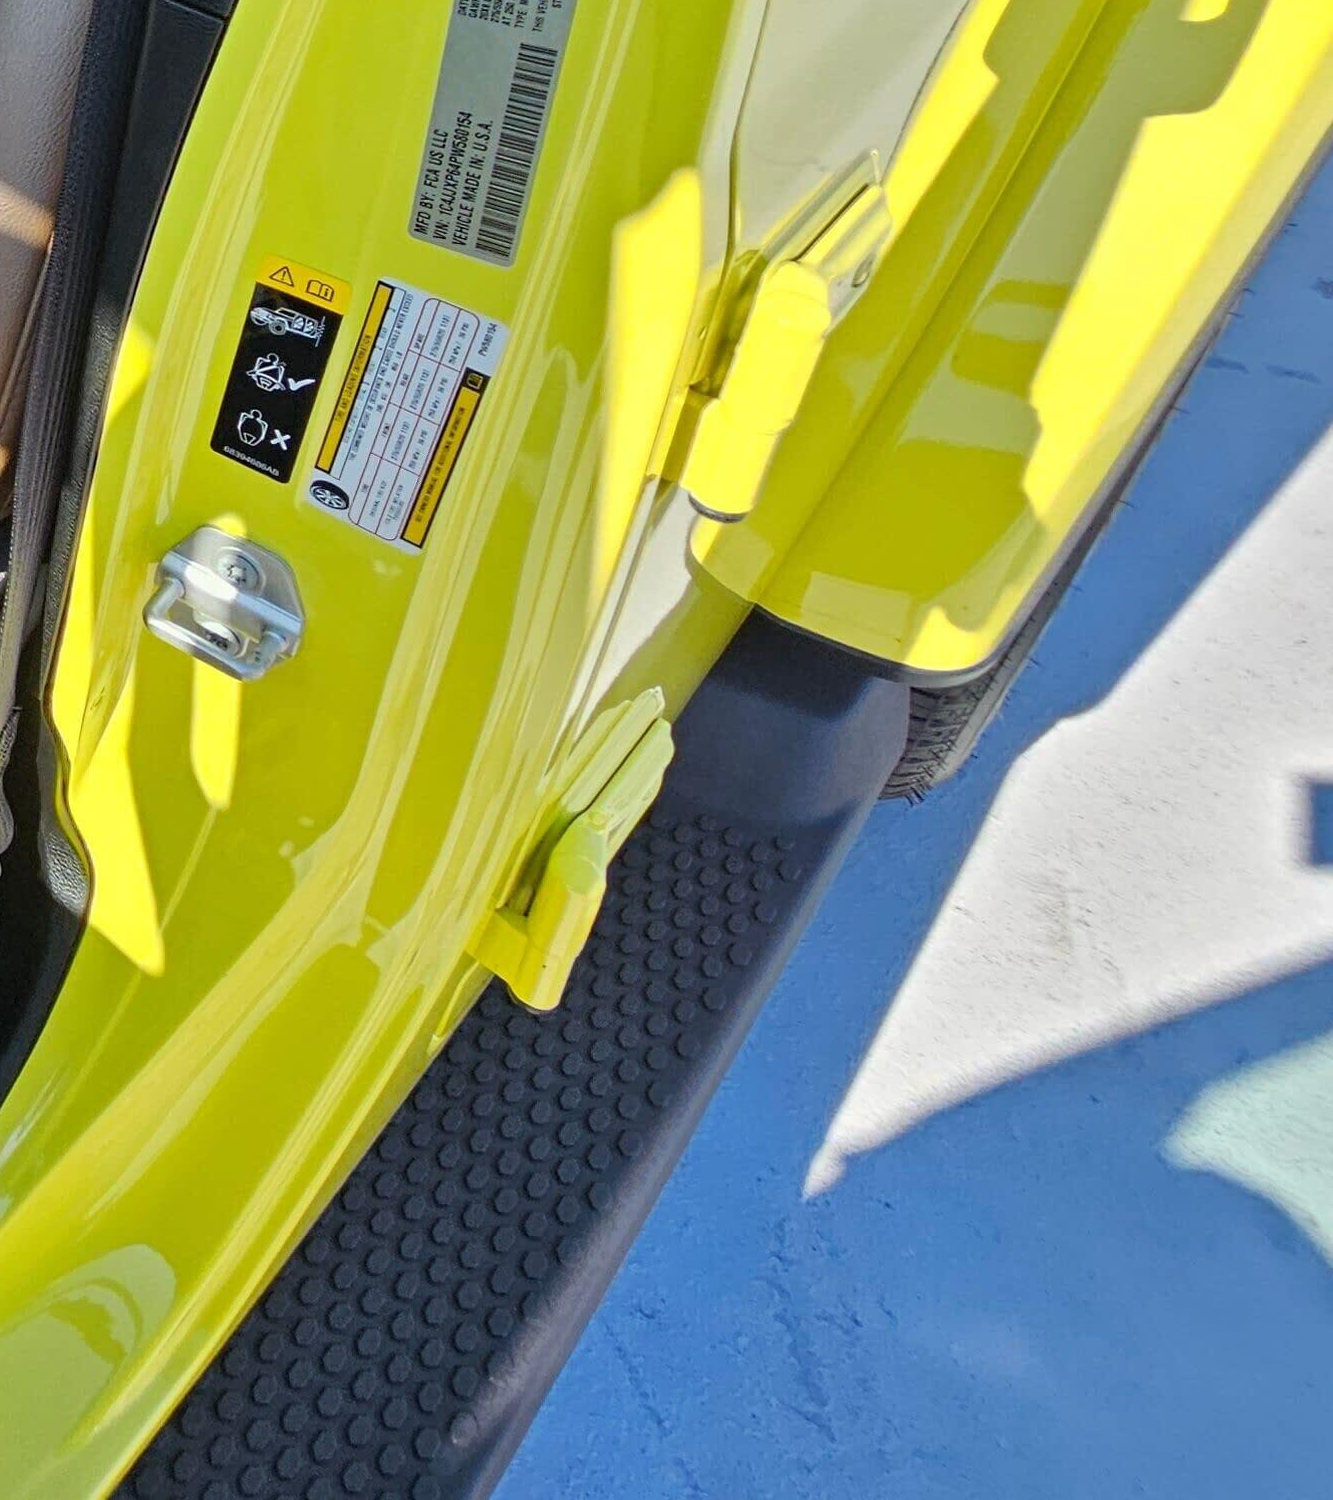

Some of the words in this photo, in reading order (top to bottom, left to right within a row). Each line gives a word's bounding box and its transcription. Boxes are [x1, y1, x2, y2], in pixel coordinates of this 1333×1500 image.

[532, 15, 545, 32] THIS
[430, 128, 448, 149] LLC
[471, 116, 493, 152] U.S.A.
[427, 149, 443, 166] US
[437, 110, 472, 216] 1C4JJXP64PW580154
[467, 152, 485, 170] IN:
[423, 167, 440, 188] FCA
[461, 171, 481, 203] MADE
[419, 190, 435, 209] BY:
[414, 210, 431, 234] MFD
[432, 218, 450, 241] VIN:
[451, 203, 474, 247] VEHICLE
